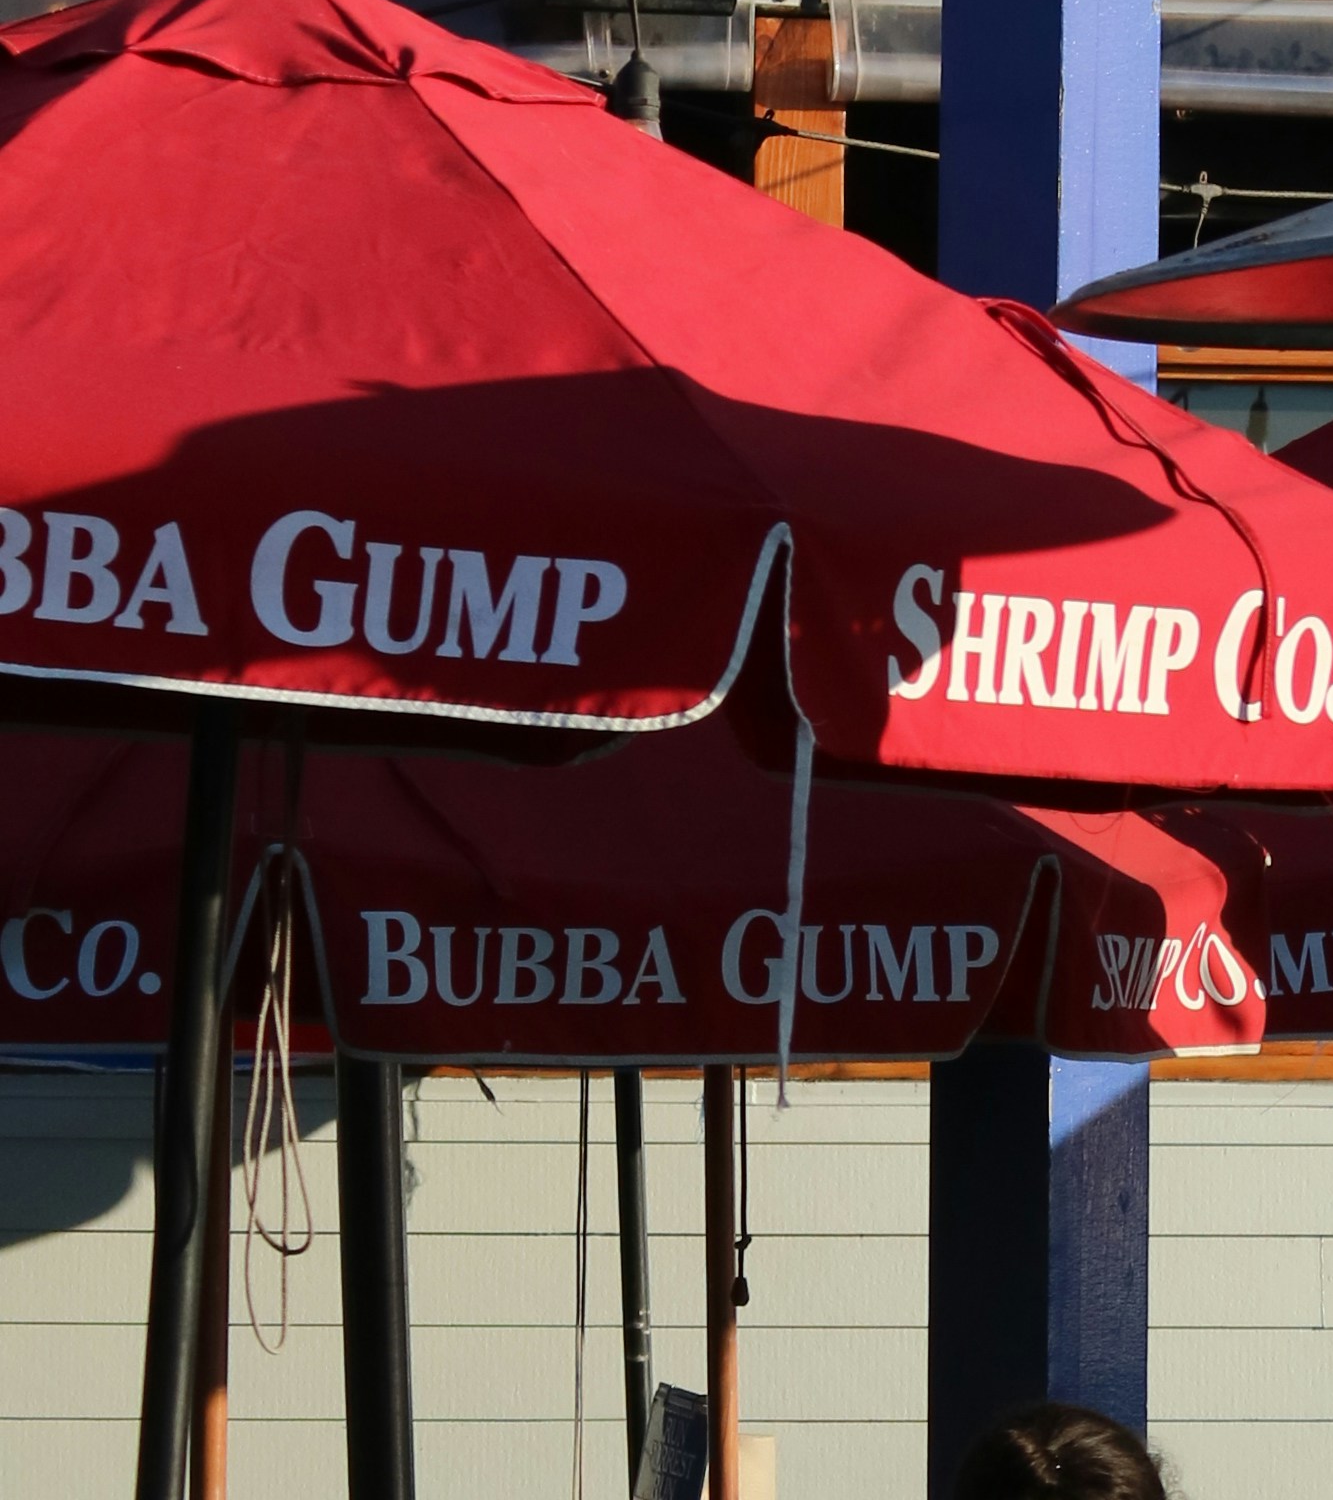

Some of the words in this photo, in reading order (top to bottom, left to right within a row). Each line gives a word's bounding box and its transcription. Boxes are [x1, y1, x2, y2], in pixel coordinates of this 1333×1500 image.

[250, 509, 629, 668] GUMP
[888, 563, 1200, 715] SHRIMP
[360, 910, 687, 1006] BUBBA
[721, 906, 999, 1005] GUMP
